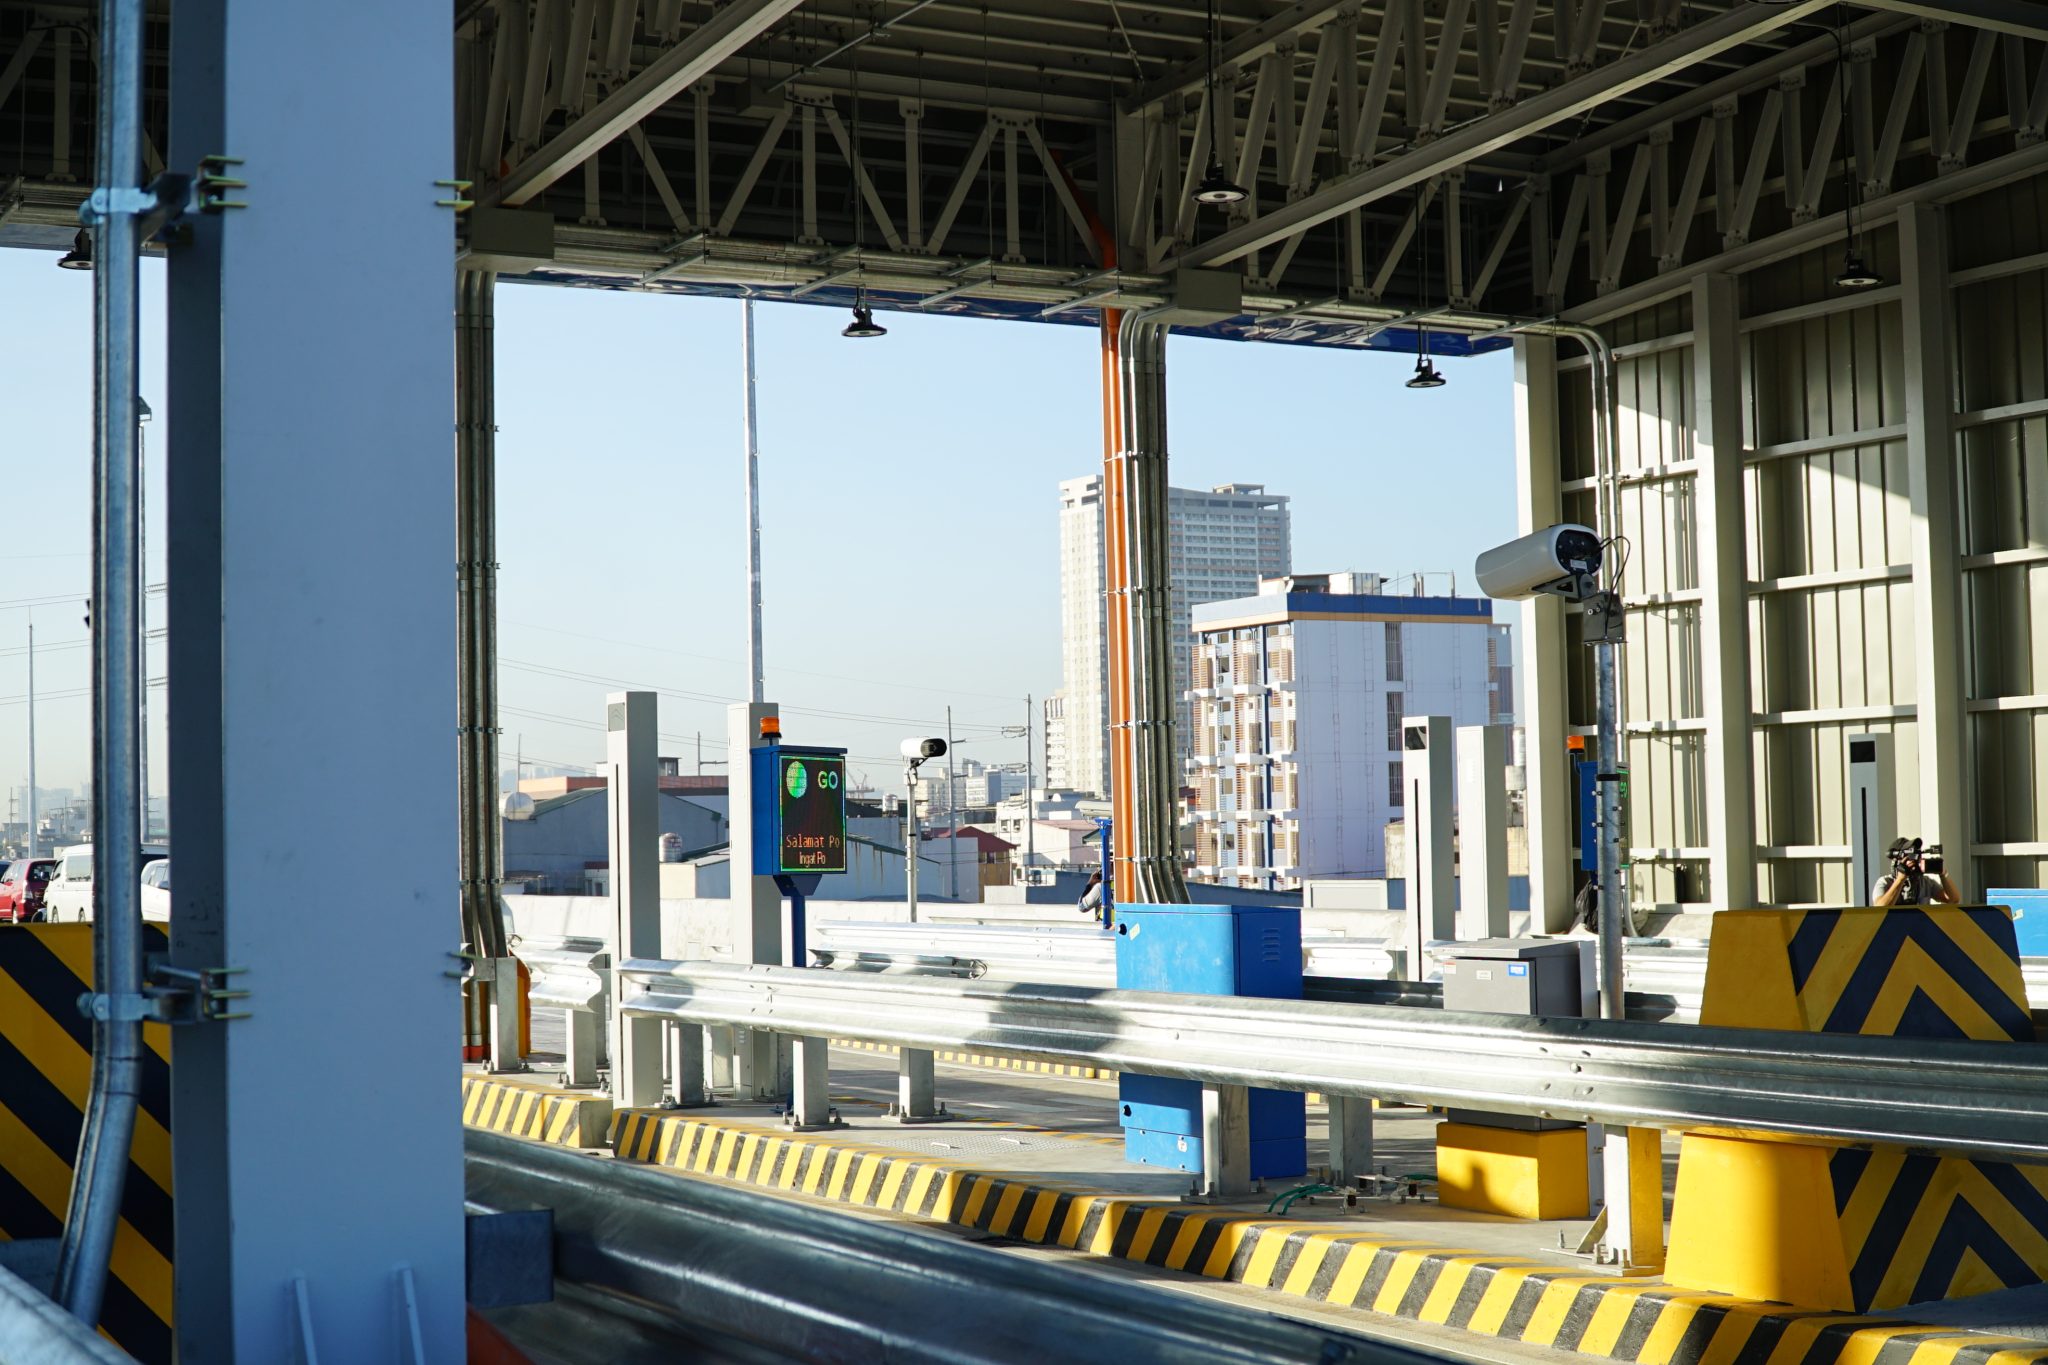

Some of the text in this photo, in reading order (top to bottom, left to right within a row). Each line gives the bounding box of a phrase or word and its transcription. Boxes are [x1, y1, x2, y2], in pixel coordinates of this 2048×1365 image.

[818, 770, 839, 790] GO
[786, 833, 840, 849] Salamat Po
[816, 851, 826, 865] Po
